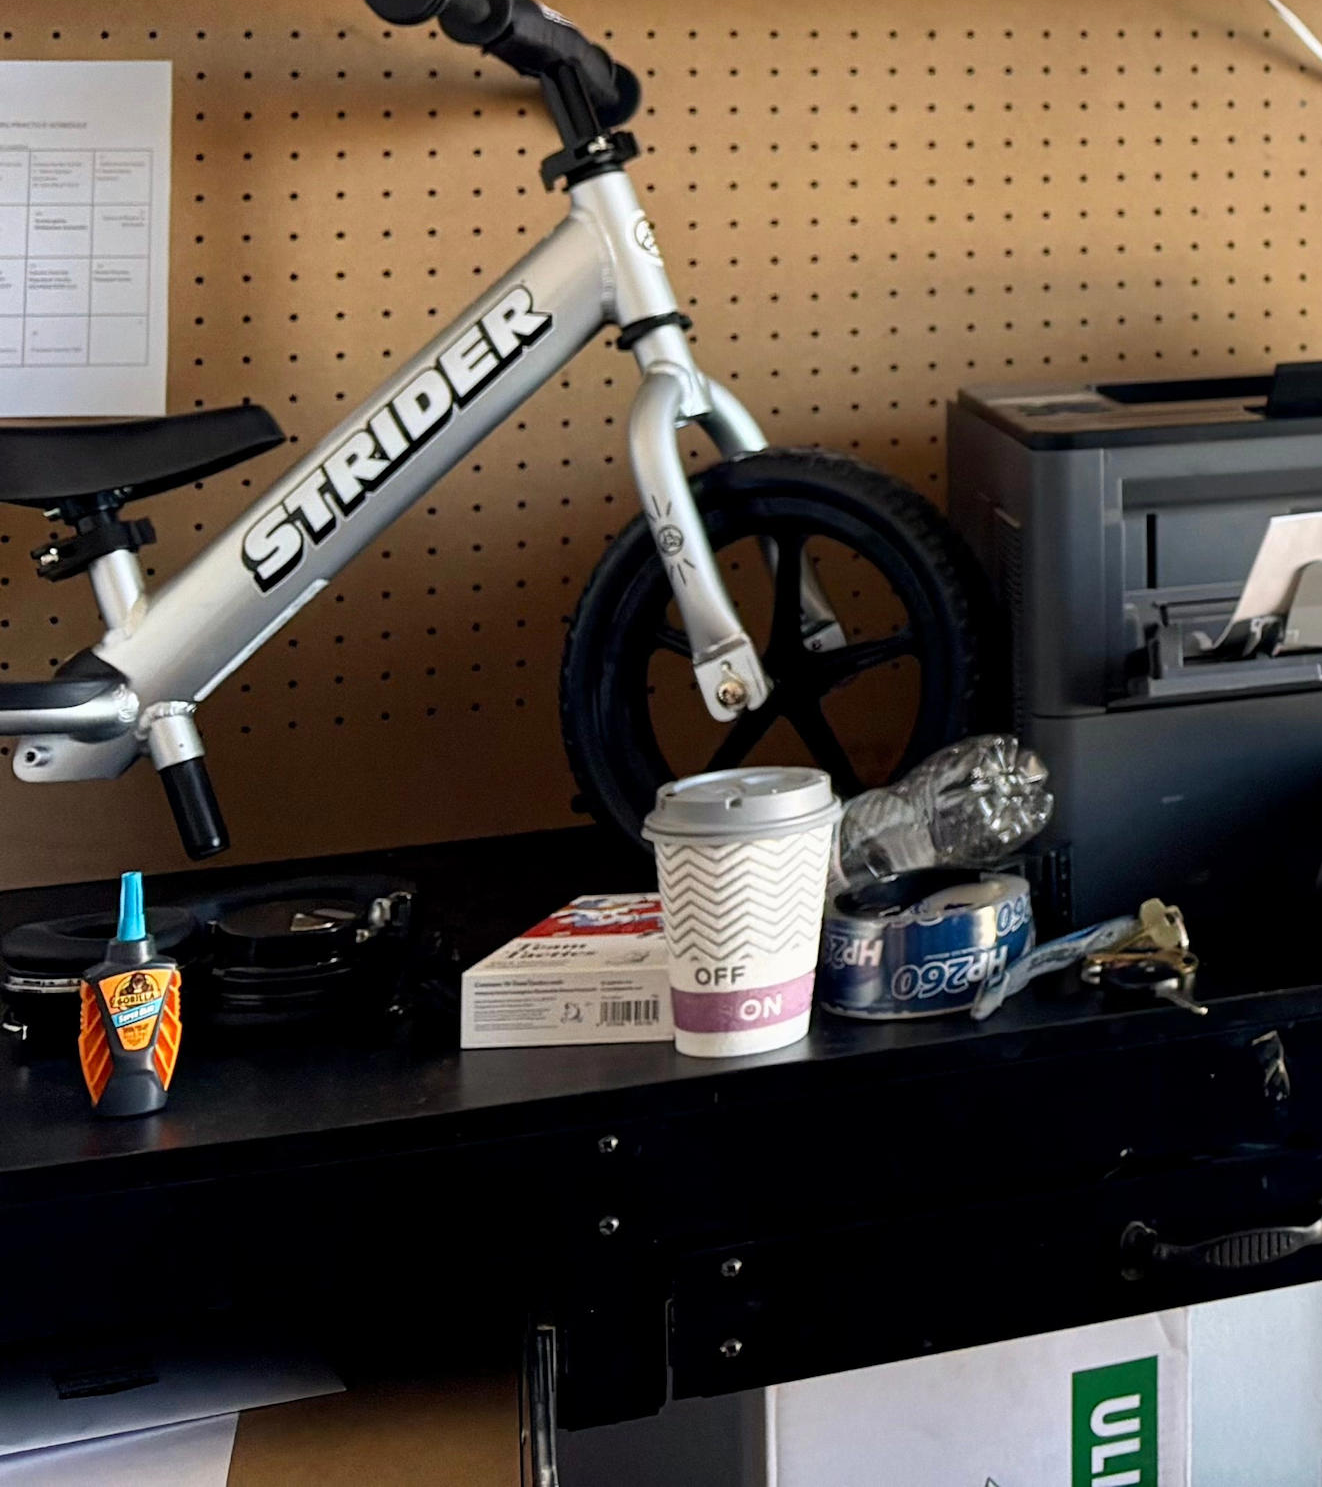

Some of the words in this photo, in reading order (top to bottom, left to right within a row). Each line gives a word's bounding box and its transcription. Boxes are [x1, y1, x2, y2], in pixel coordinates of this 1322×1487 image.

[243, 286, 552, 591] STRIDER
[996, 894, 1033, 937] 60
[694, 965, 746, 986] OFF
[891, 945, 1008, 1001] HP260
[117, 993, 155, 1006] GORILLA
[739, 993, 783, 1022] ON
[1090, 1393, 1142, 1487] ULI
